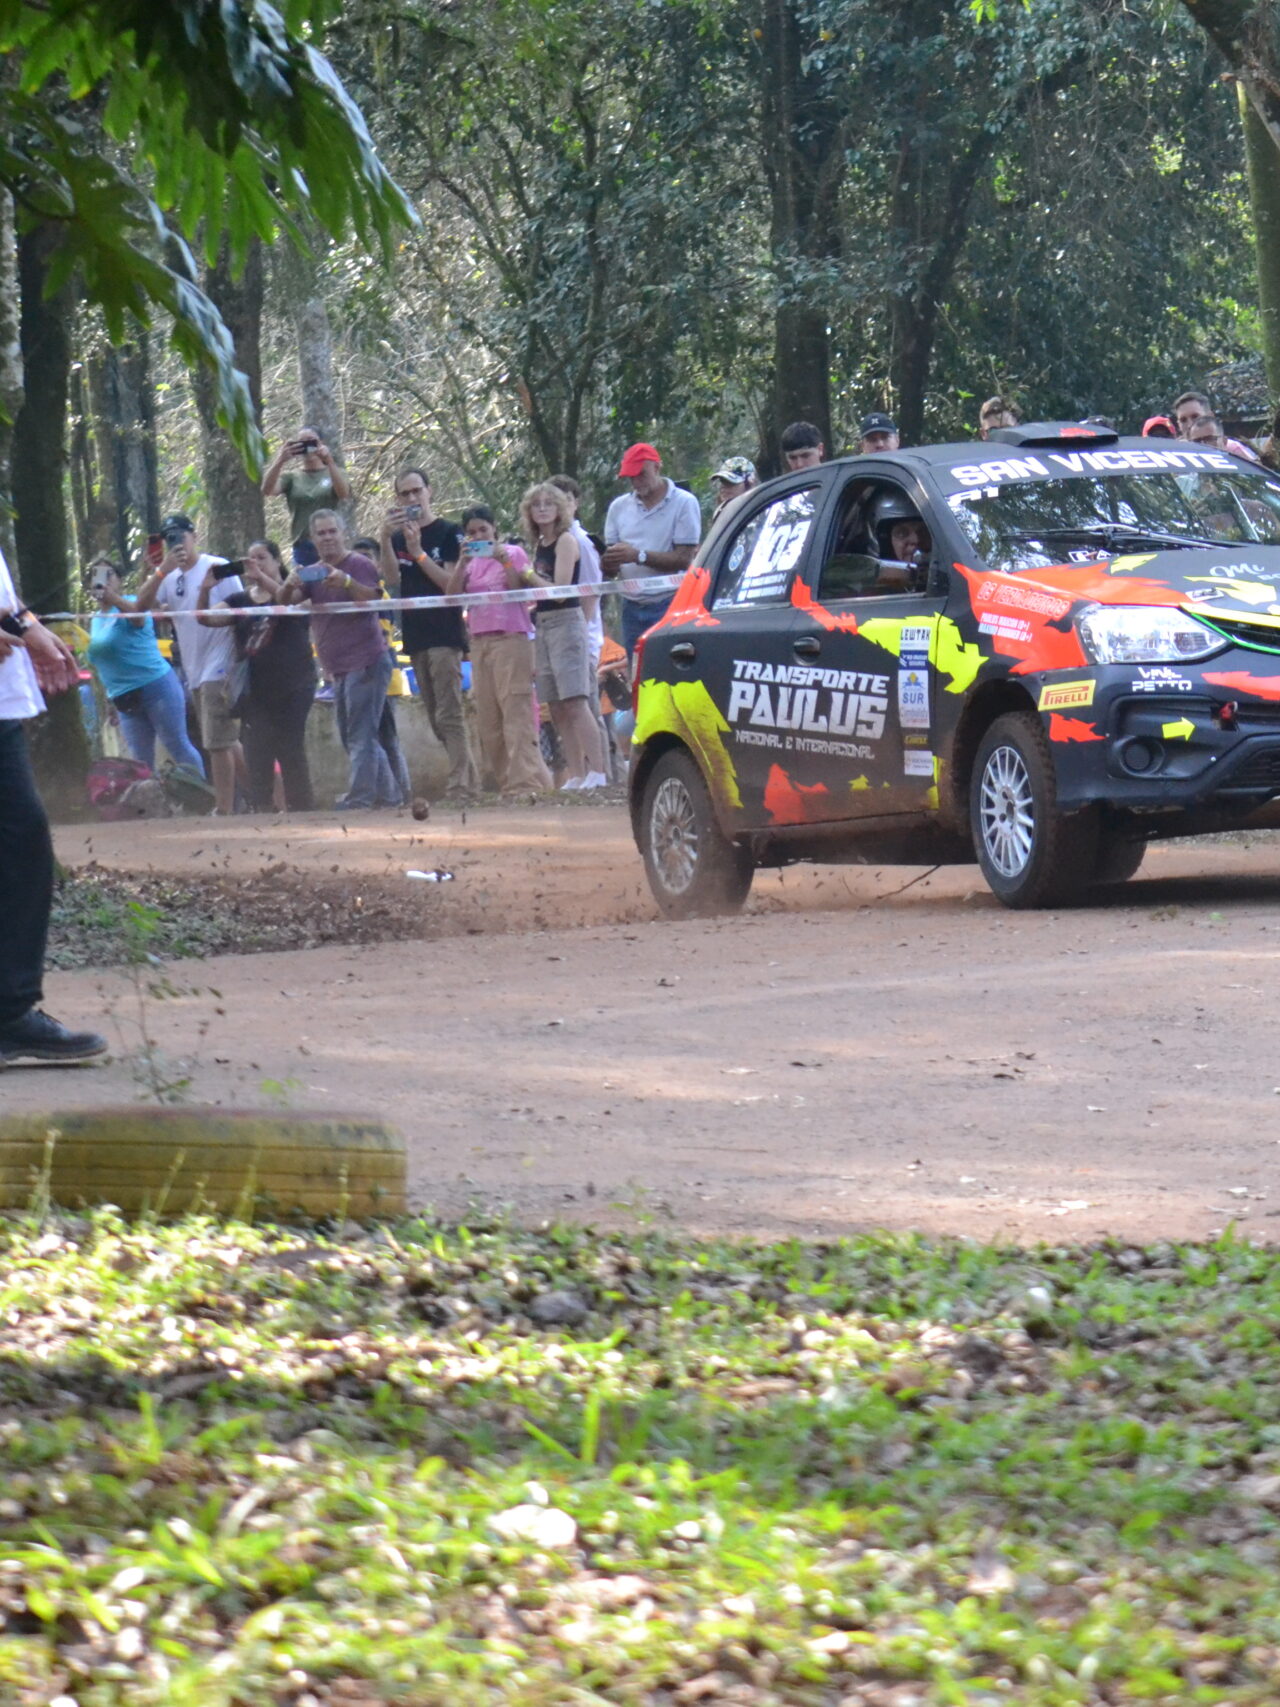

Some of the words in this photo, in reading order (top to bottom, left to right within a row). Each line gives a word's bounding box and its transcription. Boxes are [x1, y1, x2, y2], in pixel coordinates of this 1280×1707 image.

[951, 456, 1049, 486] SAN
[1048, 450, 1239, 473] VICENTE
[733, 660, 890, 695] TRANSPORTE
[727, 680, 889, 740] PAULUS
[903, 692, 924, 704] SUR
[1043, 685, 1089, 706] PIRELLI
[735, 730, 783, 749] NACIONAL
[796, 737, 875, 760] INTERNACIONAL
